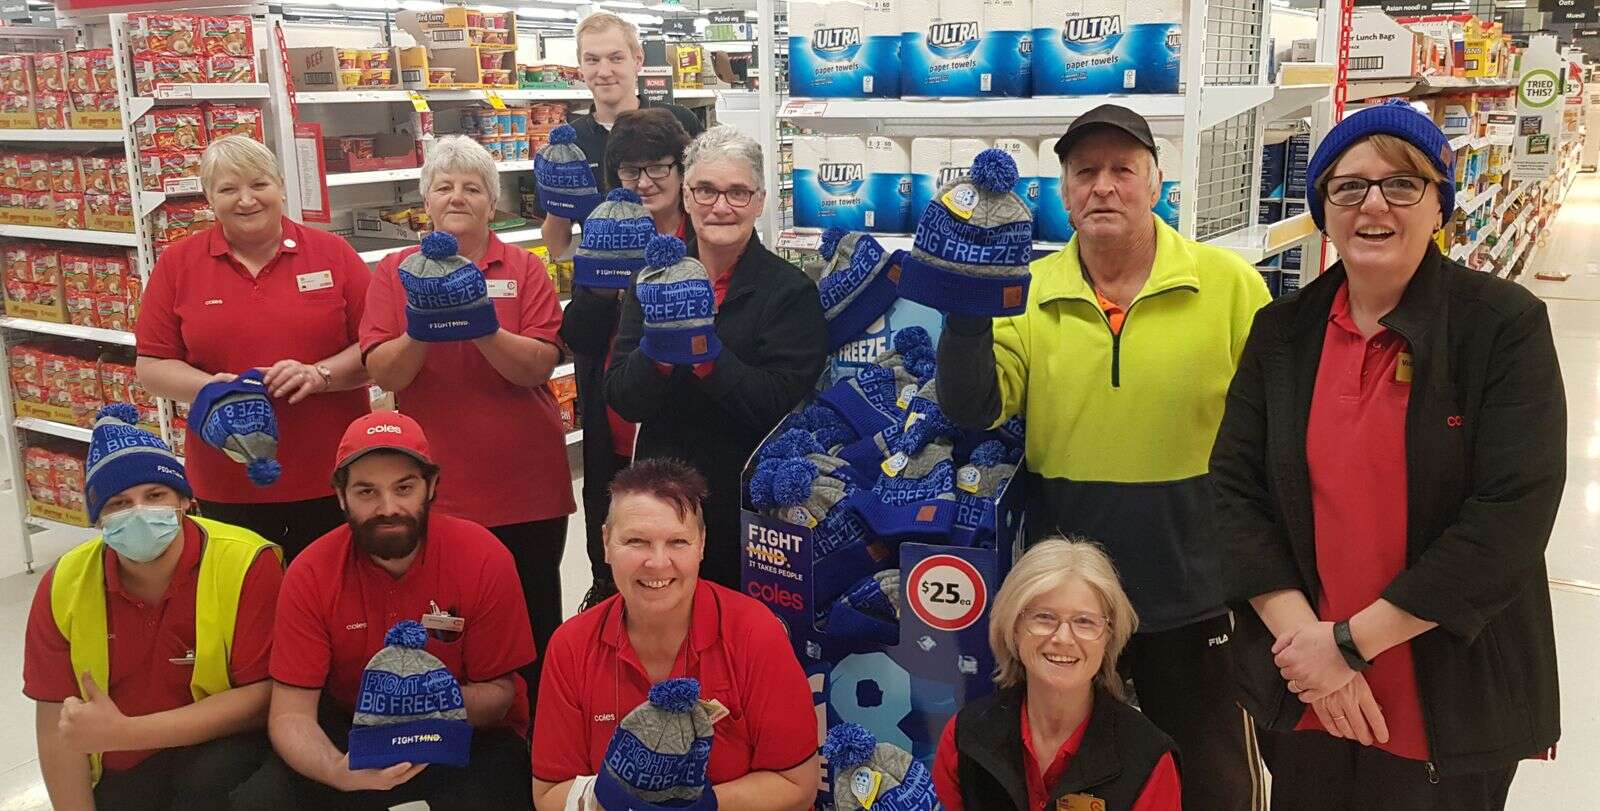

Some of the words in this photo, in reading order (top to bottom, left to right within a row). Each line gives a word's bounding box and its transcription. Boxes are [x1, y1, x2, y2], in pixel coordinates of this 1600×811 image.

[815, 27, 861, 49] ULTRA
[930, 22, 980, 45] ULTRA
[1066, 15, 1122, 41] ULTRA
[1356, 33, 1377, 41] Lunch
[1379, 33, 1396, 42] Bags
[815, 66, 835, 76] paper
[836, 62, 858, 72] towels
[930, 64, 950, 74] paper
[951, 60, 976, 70] towels
[1066, 61, 1088, 71] paper
[1090, 55, 1119, 67] towels
[1526, 88, 1552, 96] THIS?
[820, 163, 863, 183] ULTRA
[821, 199, 838, 207] paper
[838, 196, 861, 206] towels
[922, 202, 981, 243] FIGHT
[596, 233, 646, 249] FREEZE
[915, 225, 939, 253] BIG
[942, 238, 1017, 264] FREEZE
[1020, 246, 1032, 263] 8
[829, 257, 873, 304] FREEZE
[419, 284, 476, 307] FREEZE
[700, 299, 709, 316] 8
[838, 336, 887, 363] FREEZE
[366, 423, 402, 437] coles
[107, 436, 138, 451] BIG
[943, 476, 953, 491] 8
[748, 523, 803, 553] FIGHT
[749, 560, 756, 569] IT
[757, 562, 778, 574] TAKES
[778, 566, 804, 581] PEOPLE
[747, 580, 805, 611] coles
[346, 621, 367, 632] coles
[1208, 633, 1228, 647] FILA
[364, 672, 418, 697] FIGHT
[359, 690, 386, 713] BIG
[390, 690, 450, 713] FREEZE
[452, 687, 462, 705] 8
[593, 712, 616, 723] coles
[391, 733, 443, 746] FIGHTMND.
[618, 731, 679, 776] FIGHT
[608, 749, 636, 781] BIG
